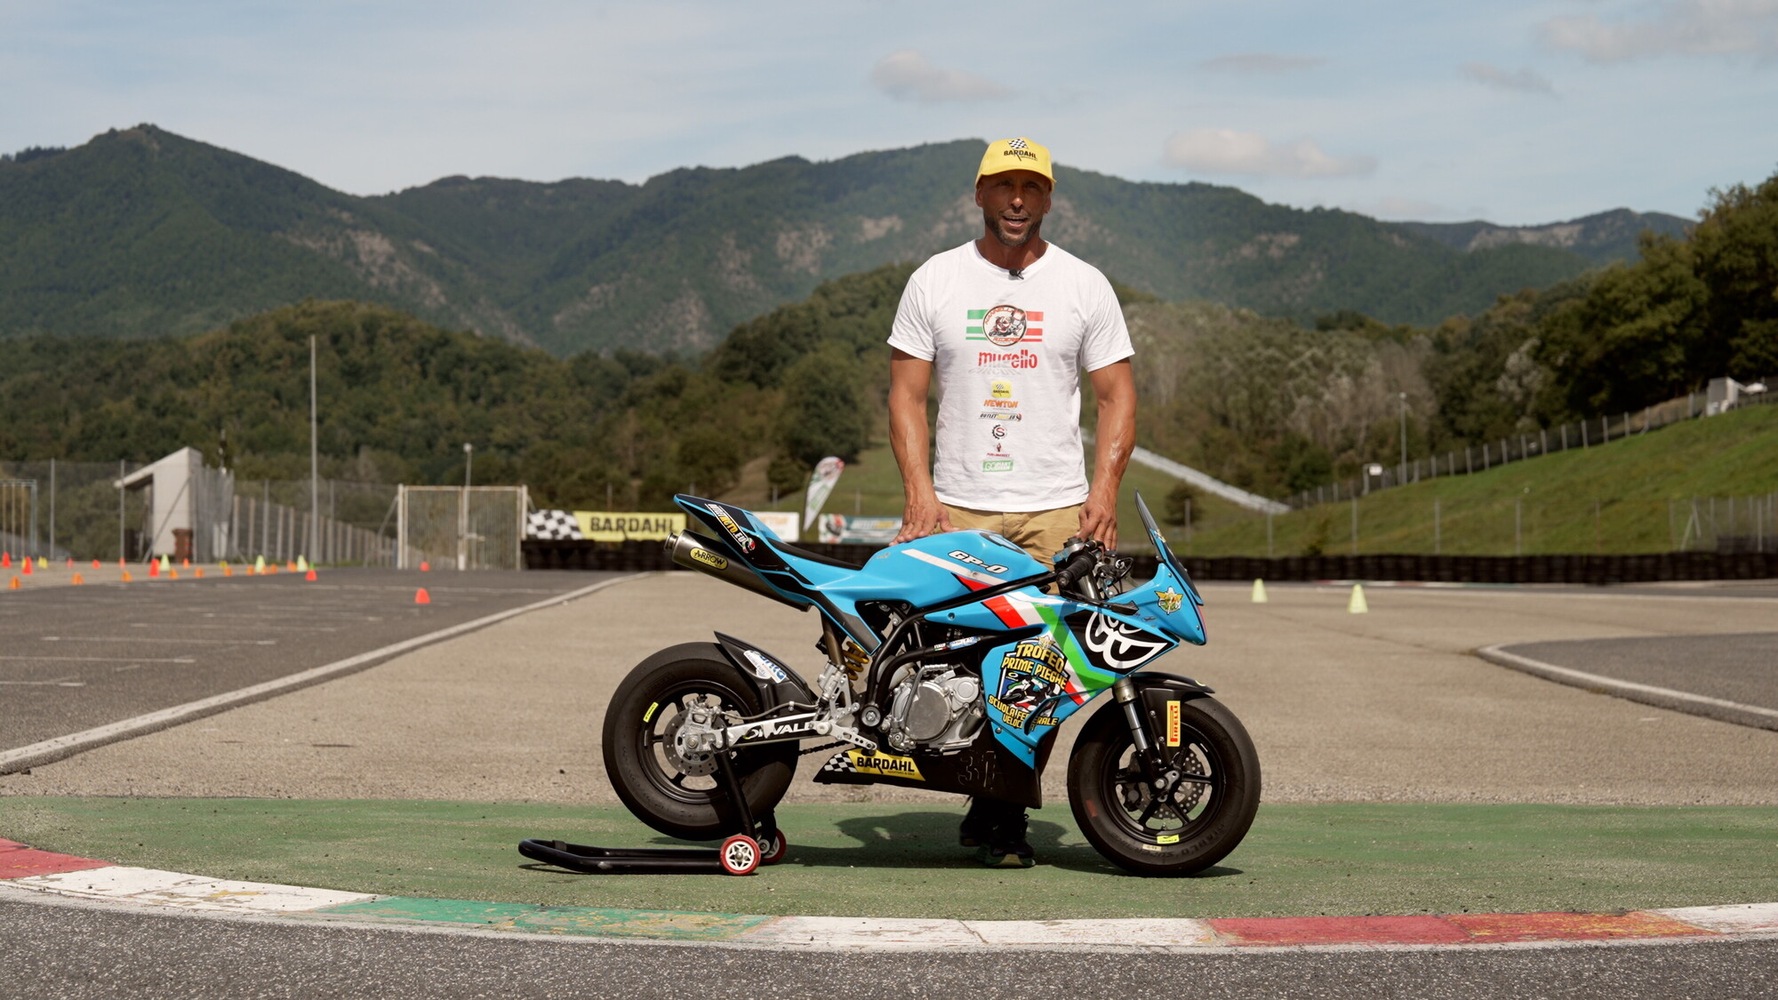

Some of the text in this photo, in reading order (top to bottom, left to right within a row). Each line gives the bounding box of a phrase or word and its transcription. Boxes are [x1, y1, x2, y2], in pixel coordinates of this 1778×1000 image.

[1003, 149, 1037, 160] BARDAHL
[978, 349, 1037, 368] mugello
[983, 399, 1018, 408] NEWTON
[590, 516, 677, 535] BARDAHL
[694, 549, 725, 565] ARROW
[1015, 643, 1065, 673] TROFEO
[1001, 656, 1068, 690] PRIME PIEGHE
[988, 694, 1016, 718] SCUOLA
[1170, 705, 1179, 742] PIRELLI
[856, 756, 915, 774] BARDAHL
